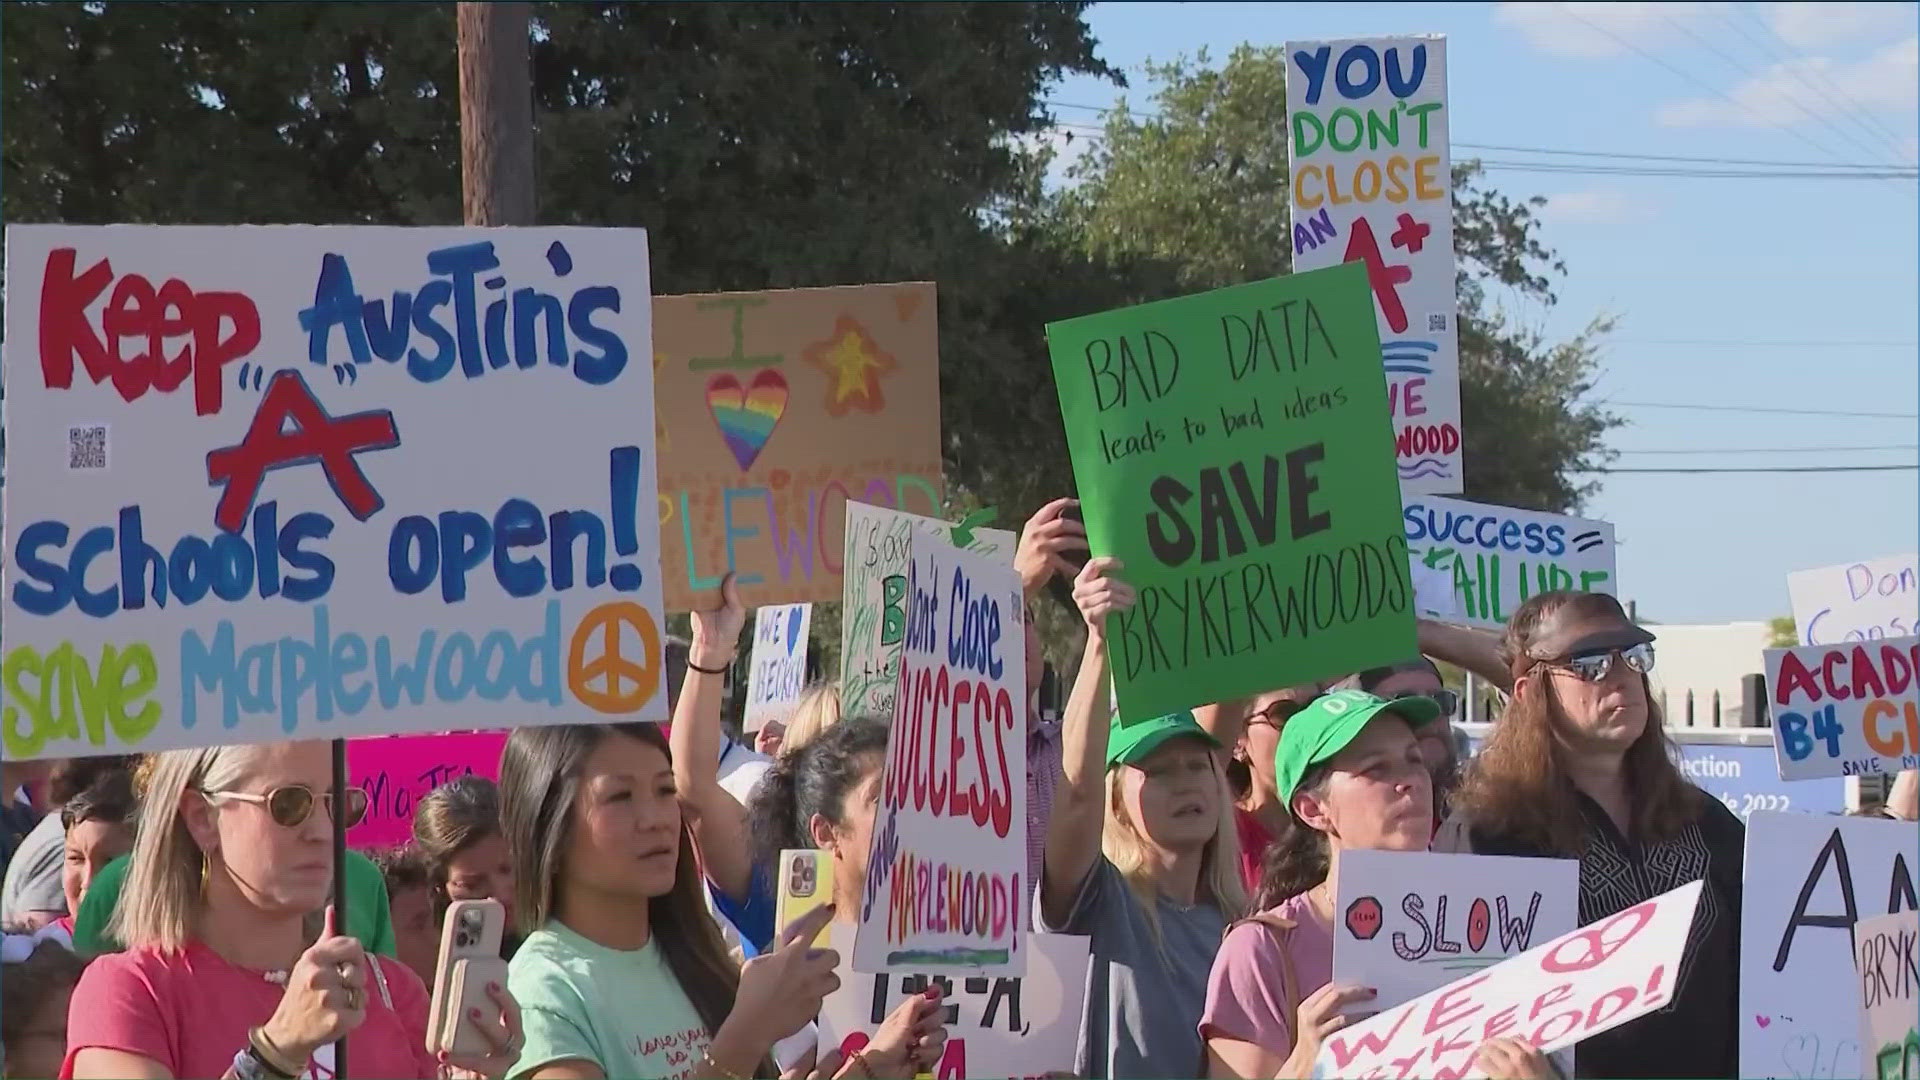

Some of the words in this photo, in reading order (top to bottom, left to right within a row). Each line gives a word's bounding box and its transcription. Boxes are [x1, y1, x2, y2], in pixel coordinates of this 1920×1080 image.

[1293, 44, 1427, 105] YOU
[1292, 100, 1443, 157] DON'T
[1294, 207, 1338, 256] AN
[1295, 155, 1444, 210] CLOSE
[1085, 330, 1180, 413] BAD
[1221, 298, 1338, 382] DATA
[1100, 420, 1167, 465] leads
[1183, 416, 1206, 446] to
[1220, 397, 1264, 438] bad
[1284, 385, 1349, 420] ideas
[388, 446, 642, 603] open!
[1145, 441, 1332, 568] SAVE
[948, 565, 1003, 681] Close
[1119, 534, 1407, 682] BRYKERWOODS
[179, 599, 563, 733] Maplewood
[885, 656, 1014, 839] SUCCESS
[1778, 704, 1844, 762] B4
[1842, 757, 1883, 776] SAVE
[886, 849, 1020, 953] MAPLEWOOD!
[1392, 892, 1542, 961] SLOW
[1329, 972, 1492, 1070] WE
